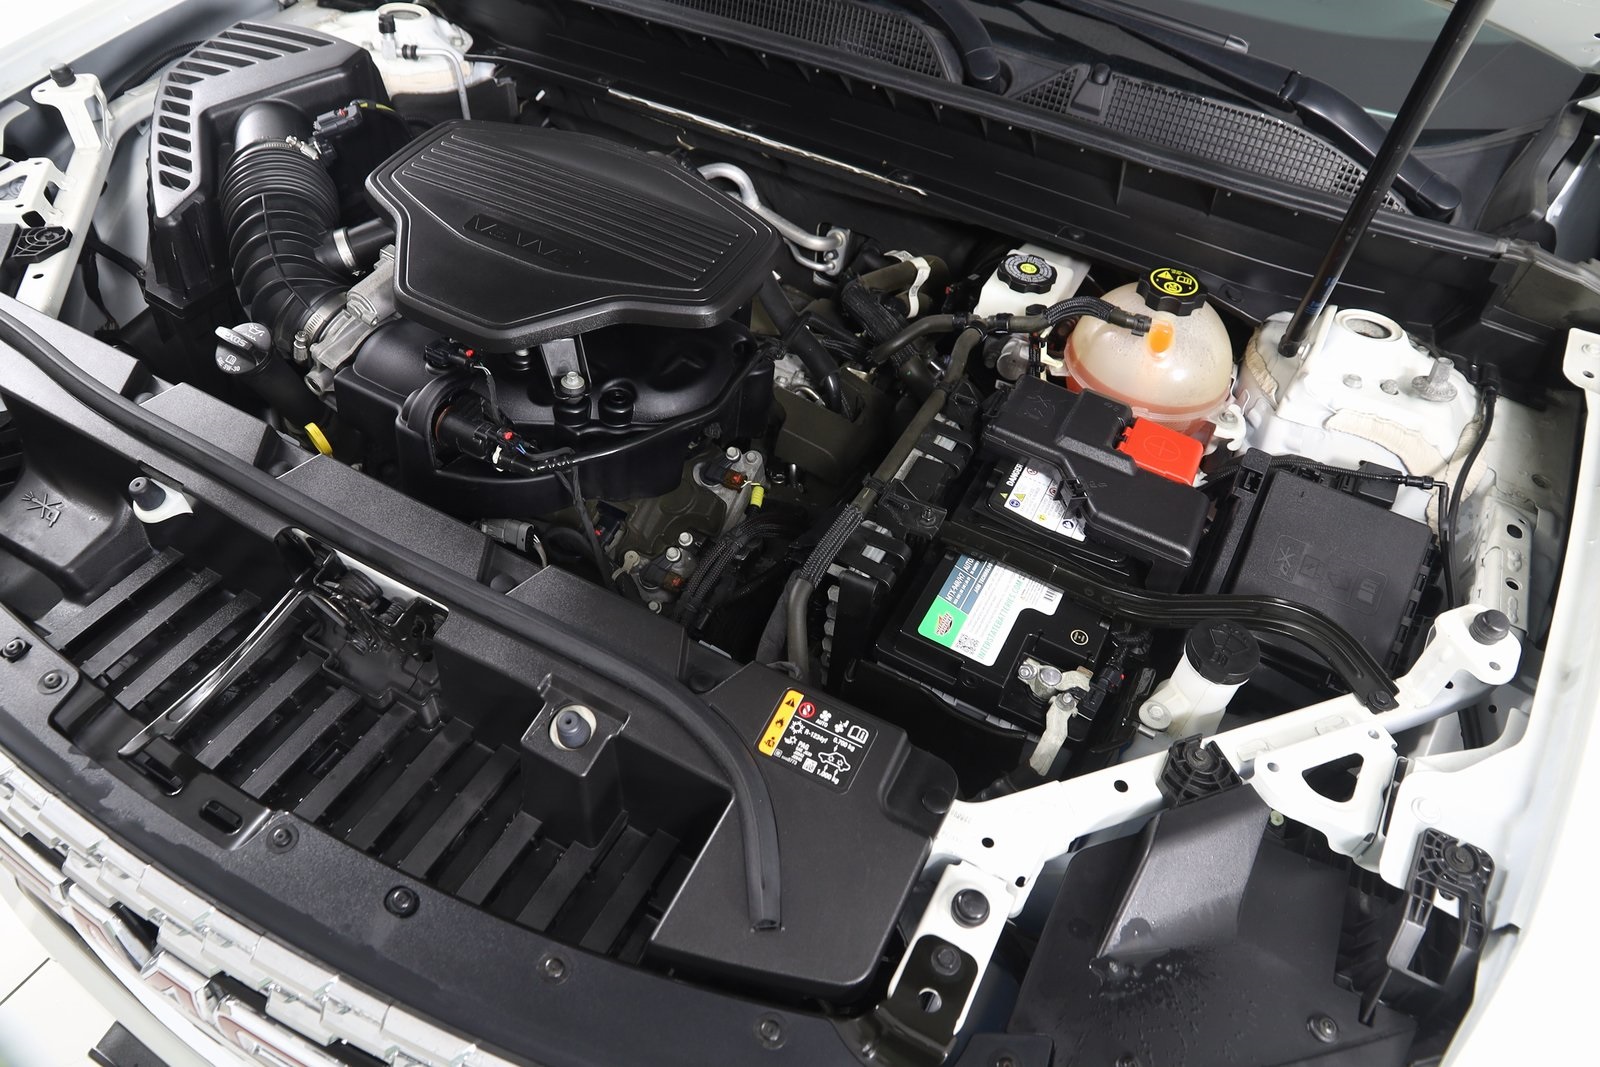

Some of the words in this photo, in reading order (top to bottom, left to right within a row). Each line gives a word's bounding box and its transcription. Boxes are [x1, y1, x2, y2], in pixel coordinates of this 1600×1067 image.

[1005, 463, 1024, 487] DANGER
[977, 577, 1025, 660] INTERSTATEBATTERIES.COM
[815, 718, 829, 728] AUTO
[798, 740, 810, 750] PAG
[847, 744, 856, 753] kg
